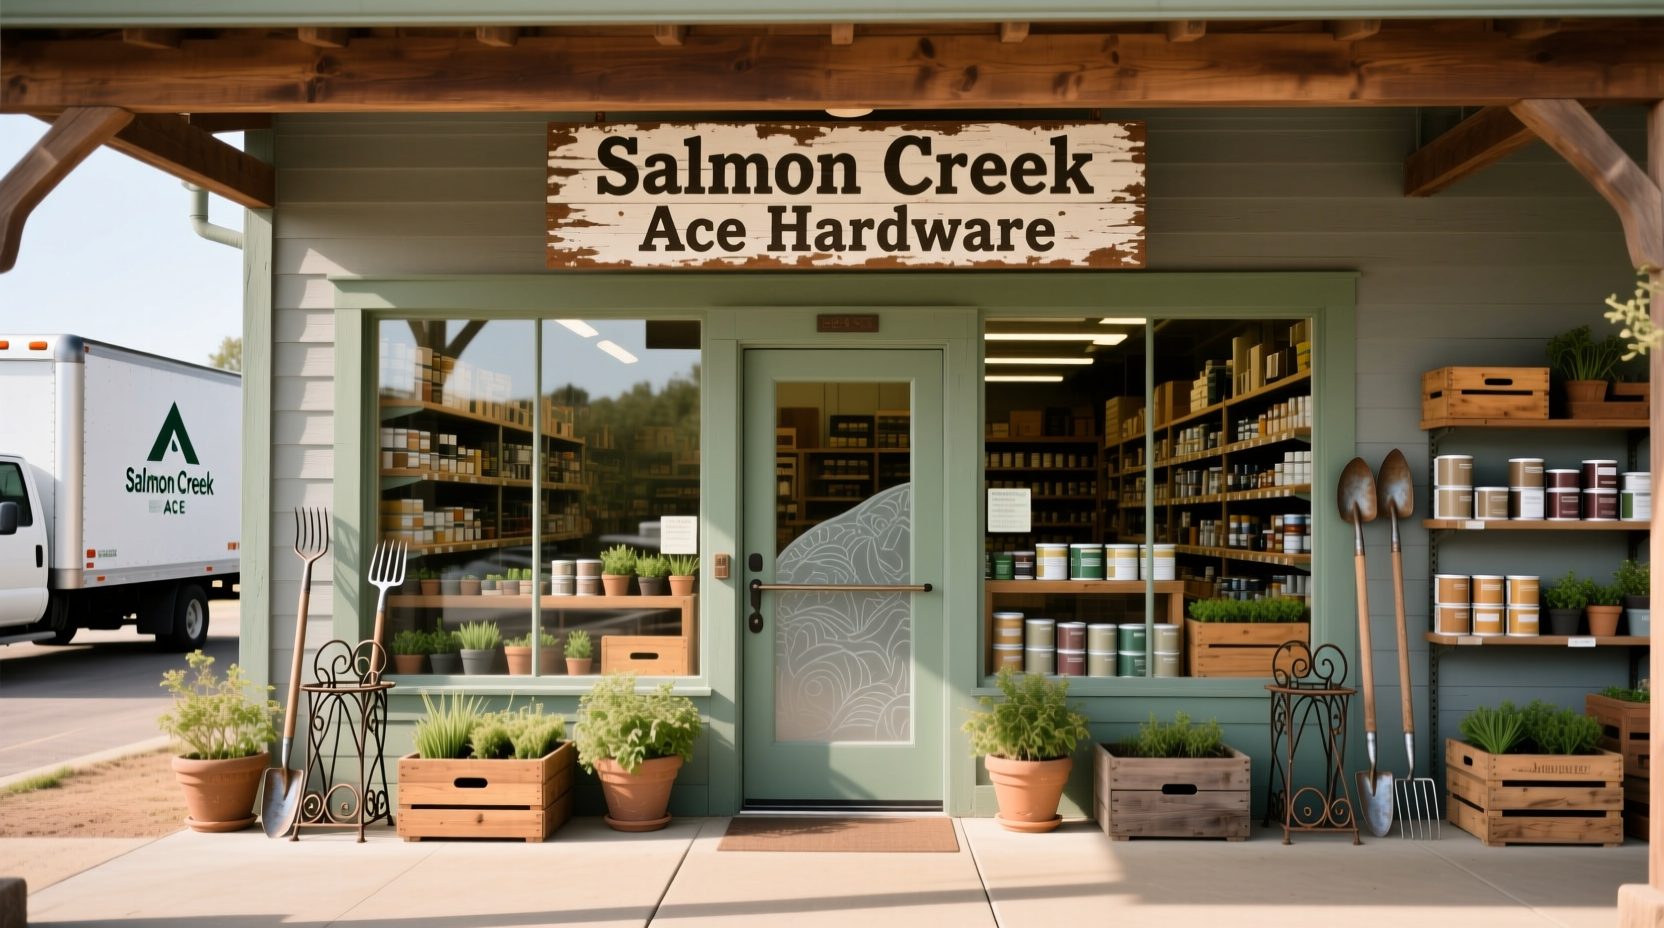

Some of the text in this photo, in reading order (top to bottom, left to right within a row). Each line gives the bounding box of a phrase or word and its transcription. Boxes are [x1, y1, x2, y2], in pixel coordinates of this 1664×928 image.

[596, 135, 1094, 196] Salmon Creek
[638, 205, 1055, 252] Ace Hardware
[126, 467, 214, 495] Salmon Creek
[163, 499, 186, 515] ACE
